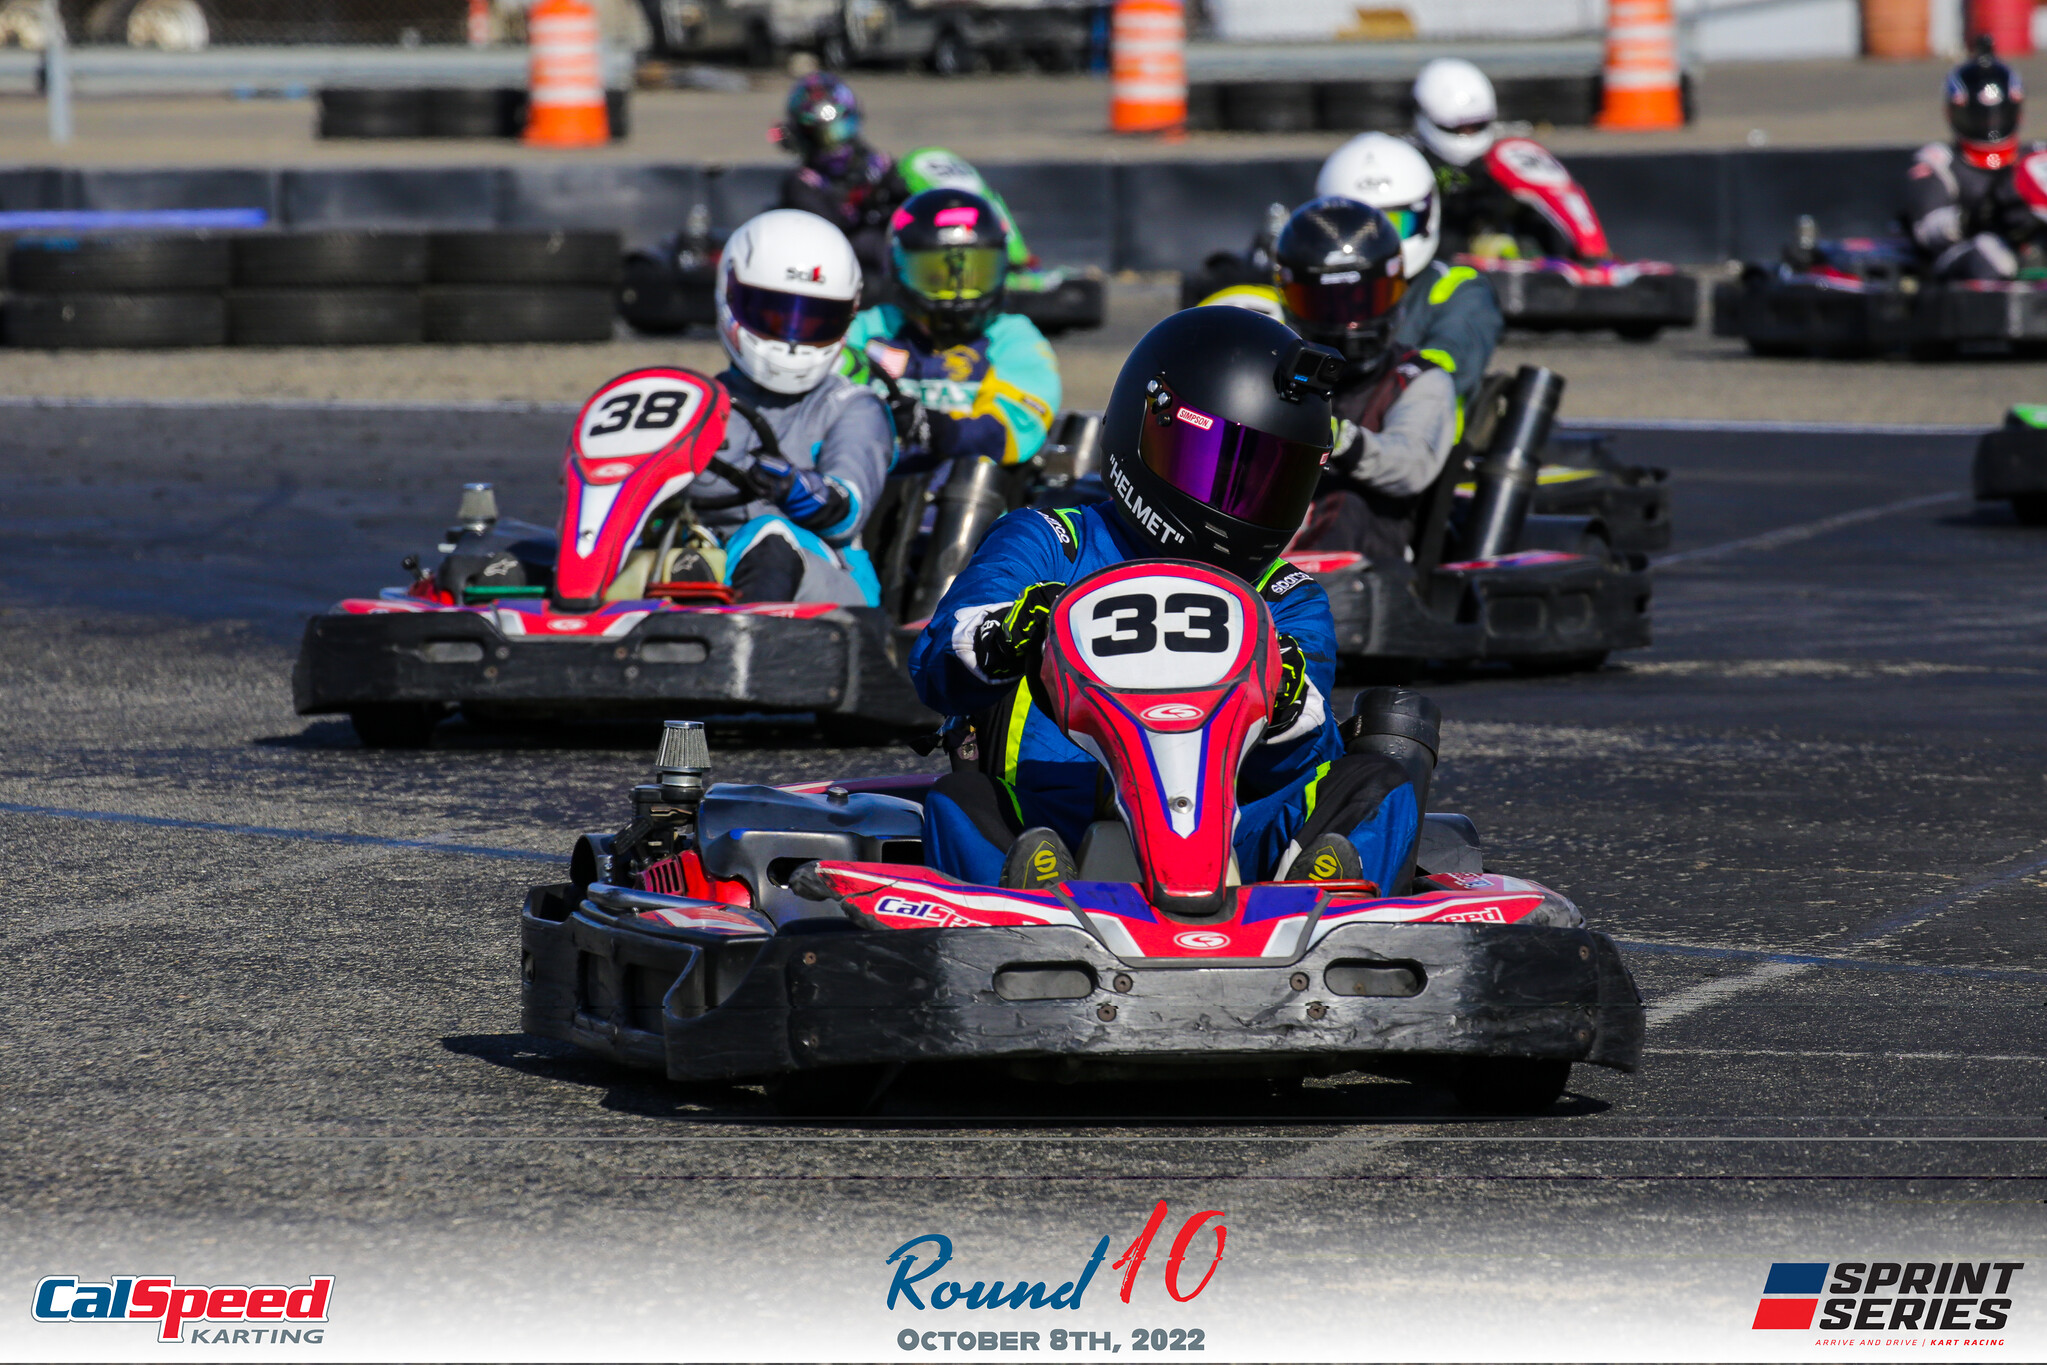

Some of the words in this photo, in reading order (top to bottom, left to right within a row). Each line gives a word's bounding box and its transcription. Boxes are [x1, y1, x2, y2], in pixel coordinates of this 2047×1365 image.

[590, 391, 688, 436] 38
[1178, 408, 1210, 427] SIMPSON
[1092, 593, 1229, 657] 33
